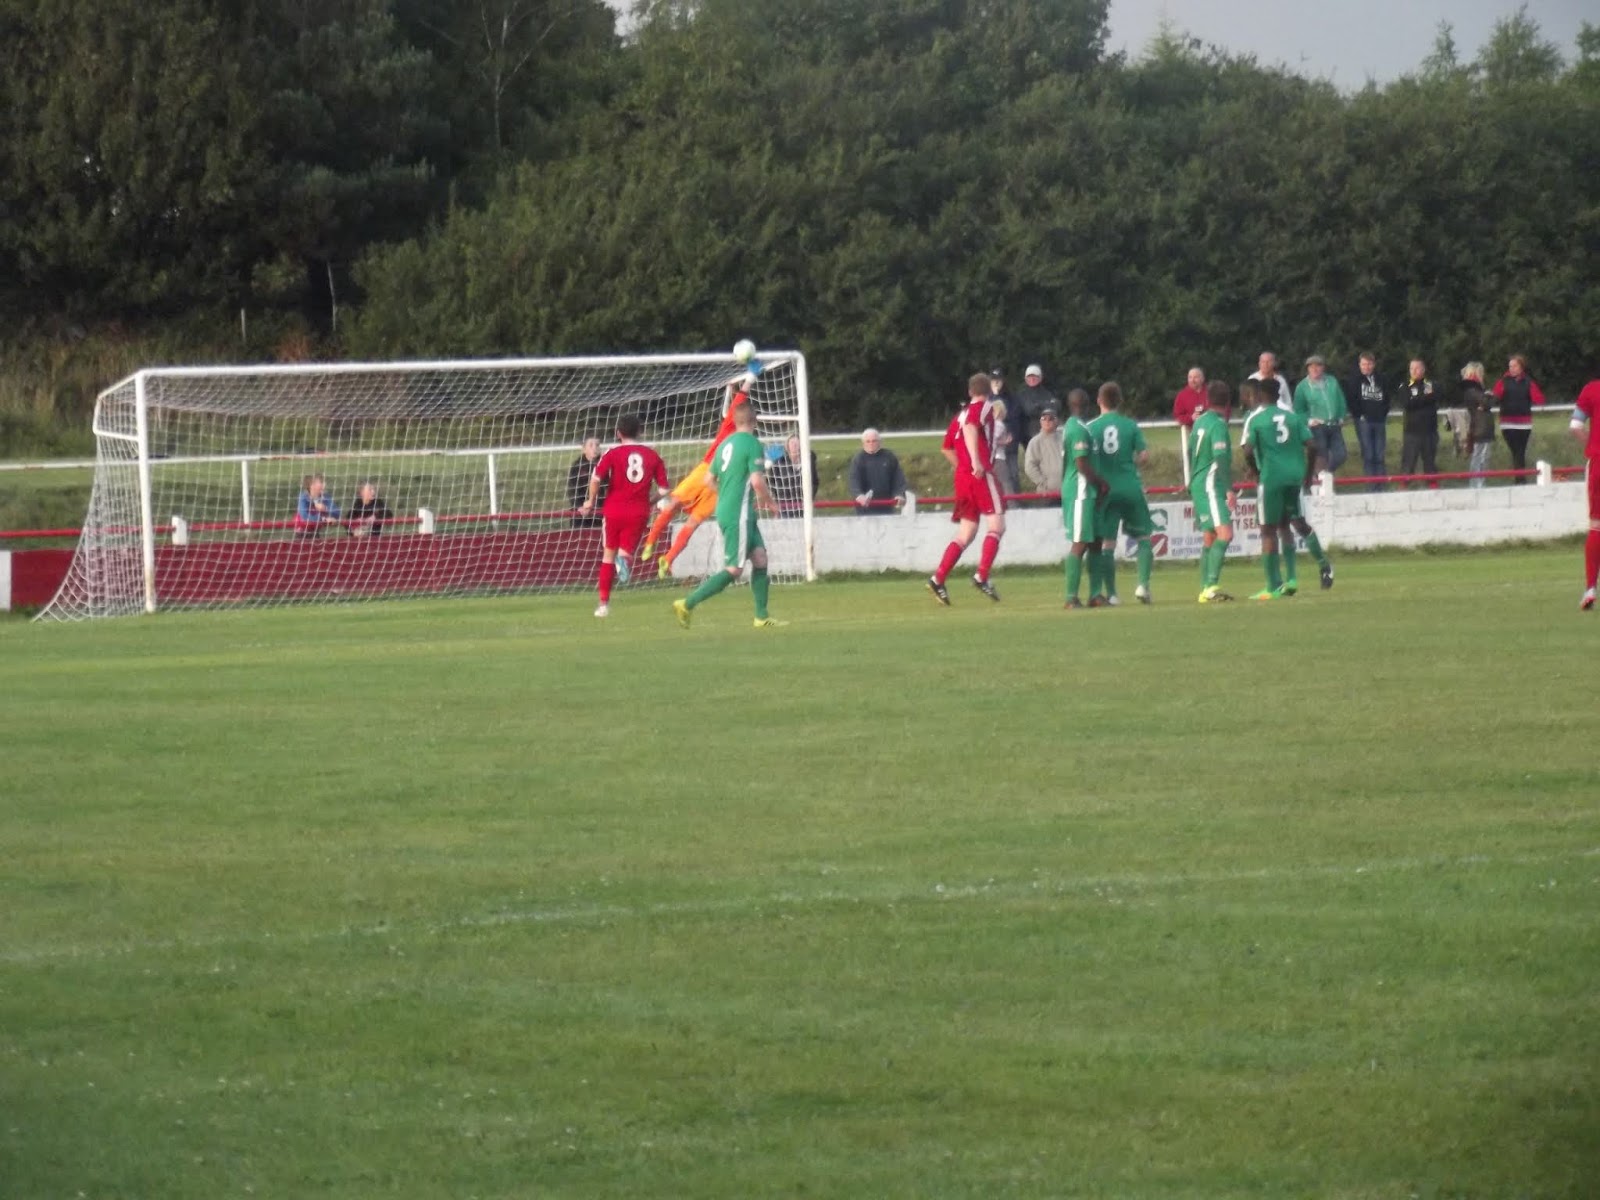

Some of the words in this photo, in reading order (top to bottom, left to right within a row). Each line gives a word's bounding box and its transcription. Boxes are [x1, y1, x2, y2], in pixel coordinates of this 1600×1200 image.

[1103, 425, 1119, 455] 8
[1272, 414, 1289, 444] 3
[627, 453, 644, 483] 8
[721, 443, 733, 472] 9
